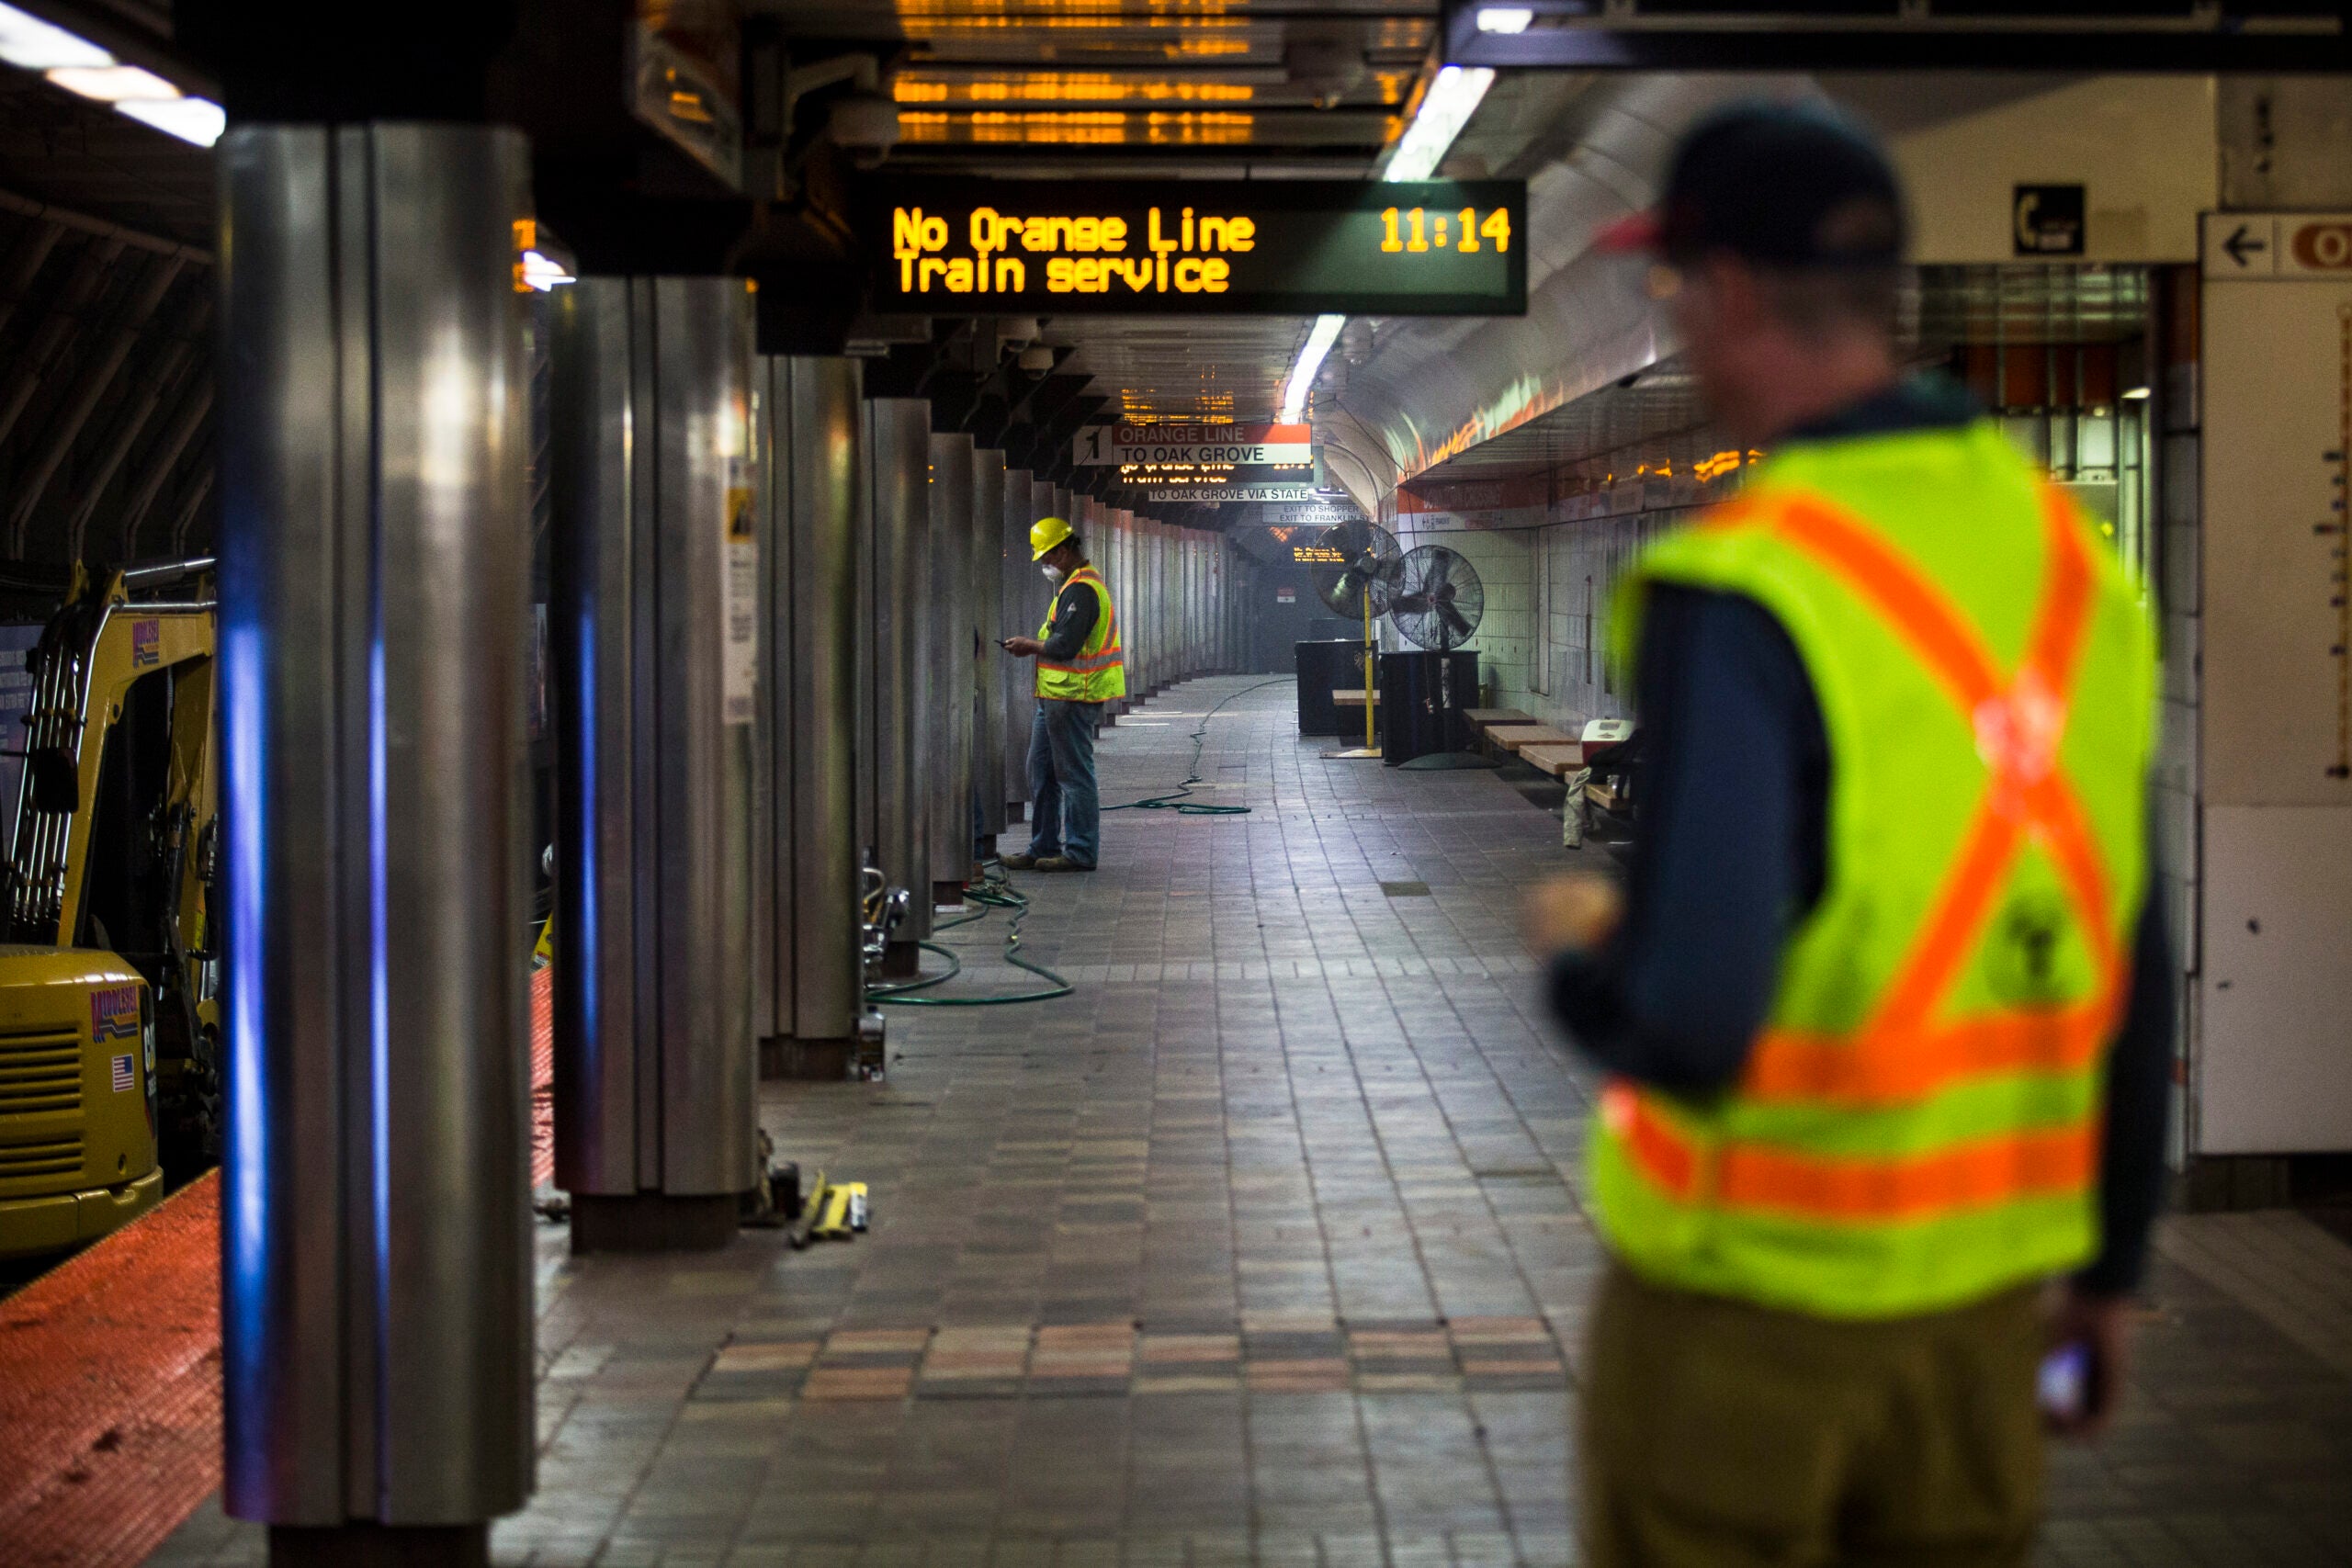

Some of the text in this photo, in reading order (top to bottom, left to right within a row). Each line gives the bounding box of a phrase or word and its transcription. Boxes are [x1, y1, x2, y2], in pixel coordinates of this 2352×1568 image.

[893, 208, 1256, 254] No Orange Line
[1381, 208, 1512, 253] 11:14
[895, 249, 1230, 293] Train service
[1086, 432, 1101, 459] 1
[1120, 426, 1245, 444] ORANGE LINE
[1121, 446, 1264, 462] TO OAK GROVE
[1150, 490, 1307, 500] TO OAK GROVE VIA STATE
